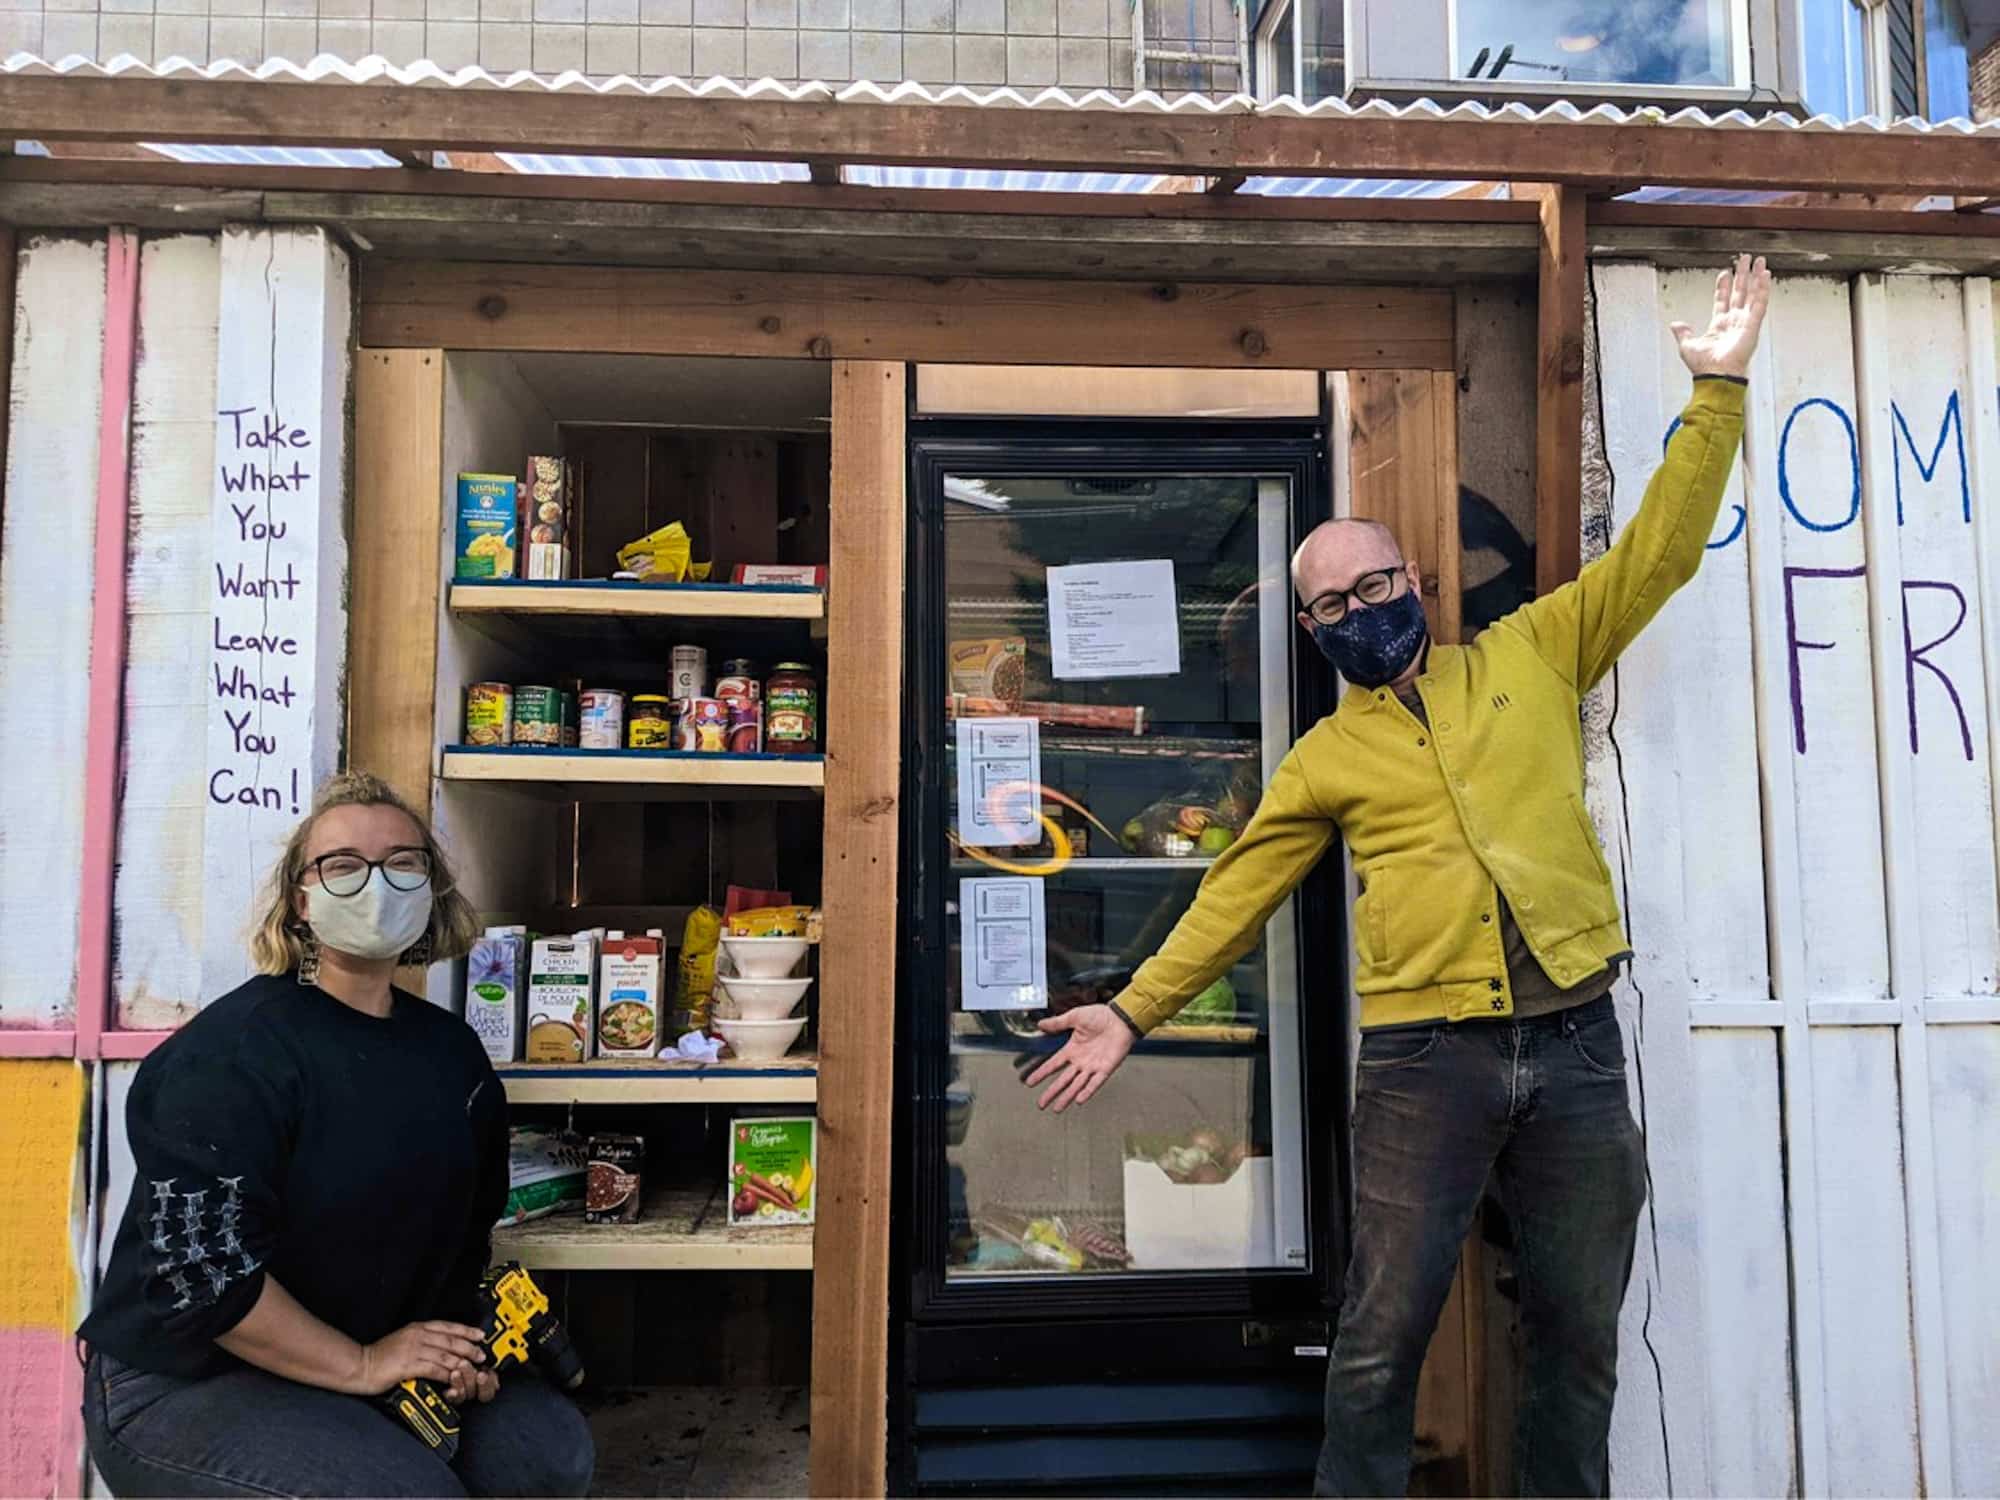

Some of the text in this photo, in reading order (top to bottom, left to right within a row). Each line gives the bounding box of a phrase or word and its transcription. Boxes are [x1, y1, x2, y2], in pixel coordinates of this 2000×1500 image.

[218, 407, 311, 450] Take
[221, 461, 311, 495] What
[1663, 387, 2000, 549] OM
[231, 503, 288, 541] You
[216, 562, 301, 600] Want
[214, 616, 298, 656] Leave
[214, 662, 297, 709] What
[224, 709, 277, 755] You
[209, 767, 300, 815] Can!
